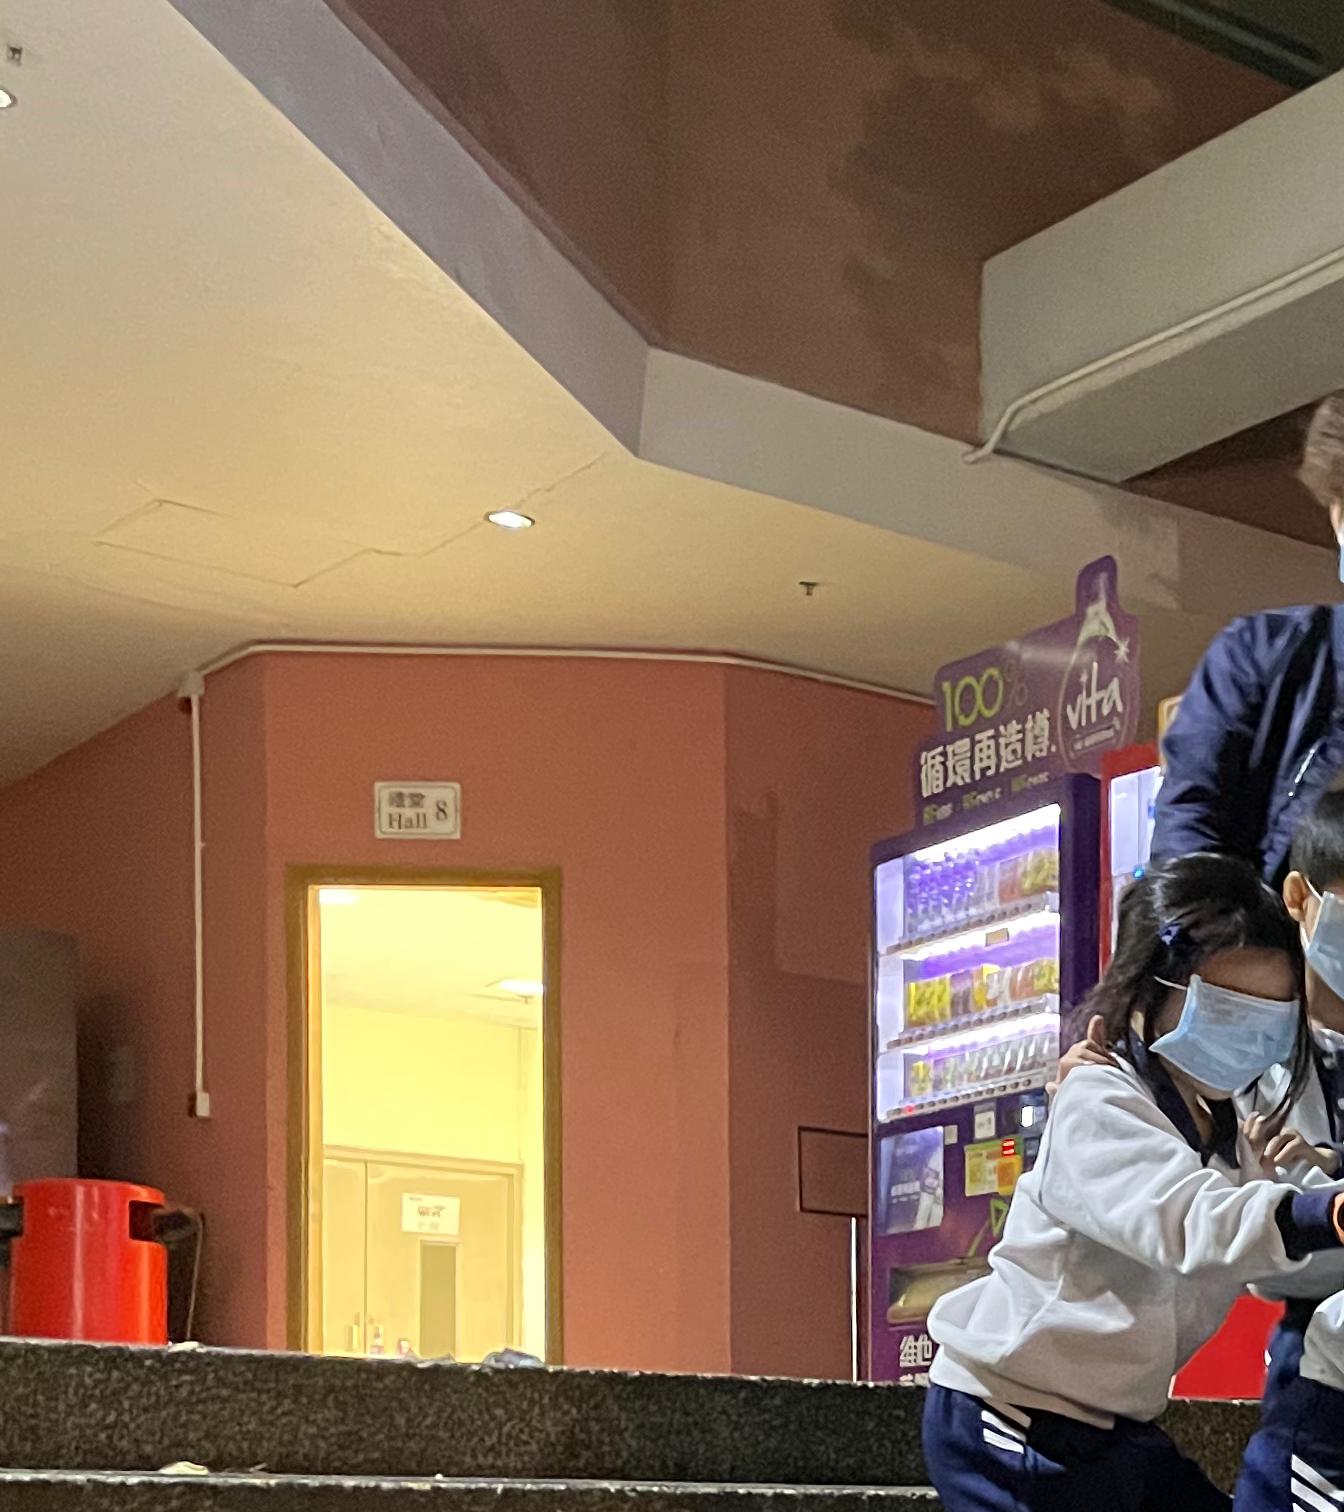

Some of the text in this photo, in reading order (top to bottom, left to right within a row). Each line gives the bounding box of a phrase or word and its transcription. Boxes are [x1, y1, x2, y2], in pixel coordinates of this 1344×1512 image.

[1066, 661, 1123, 730] vita
[388, 800, 448, 830] Hall 8
